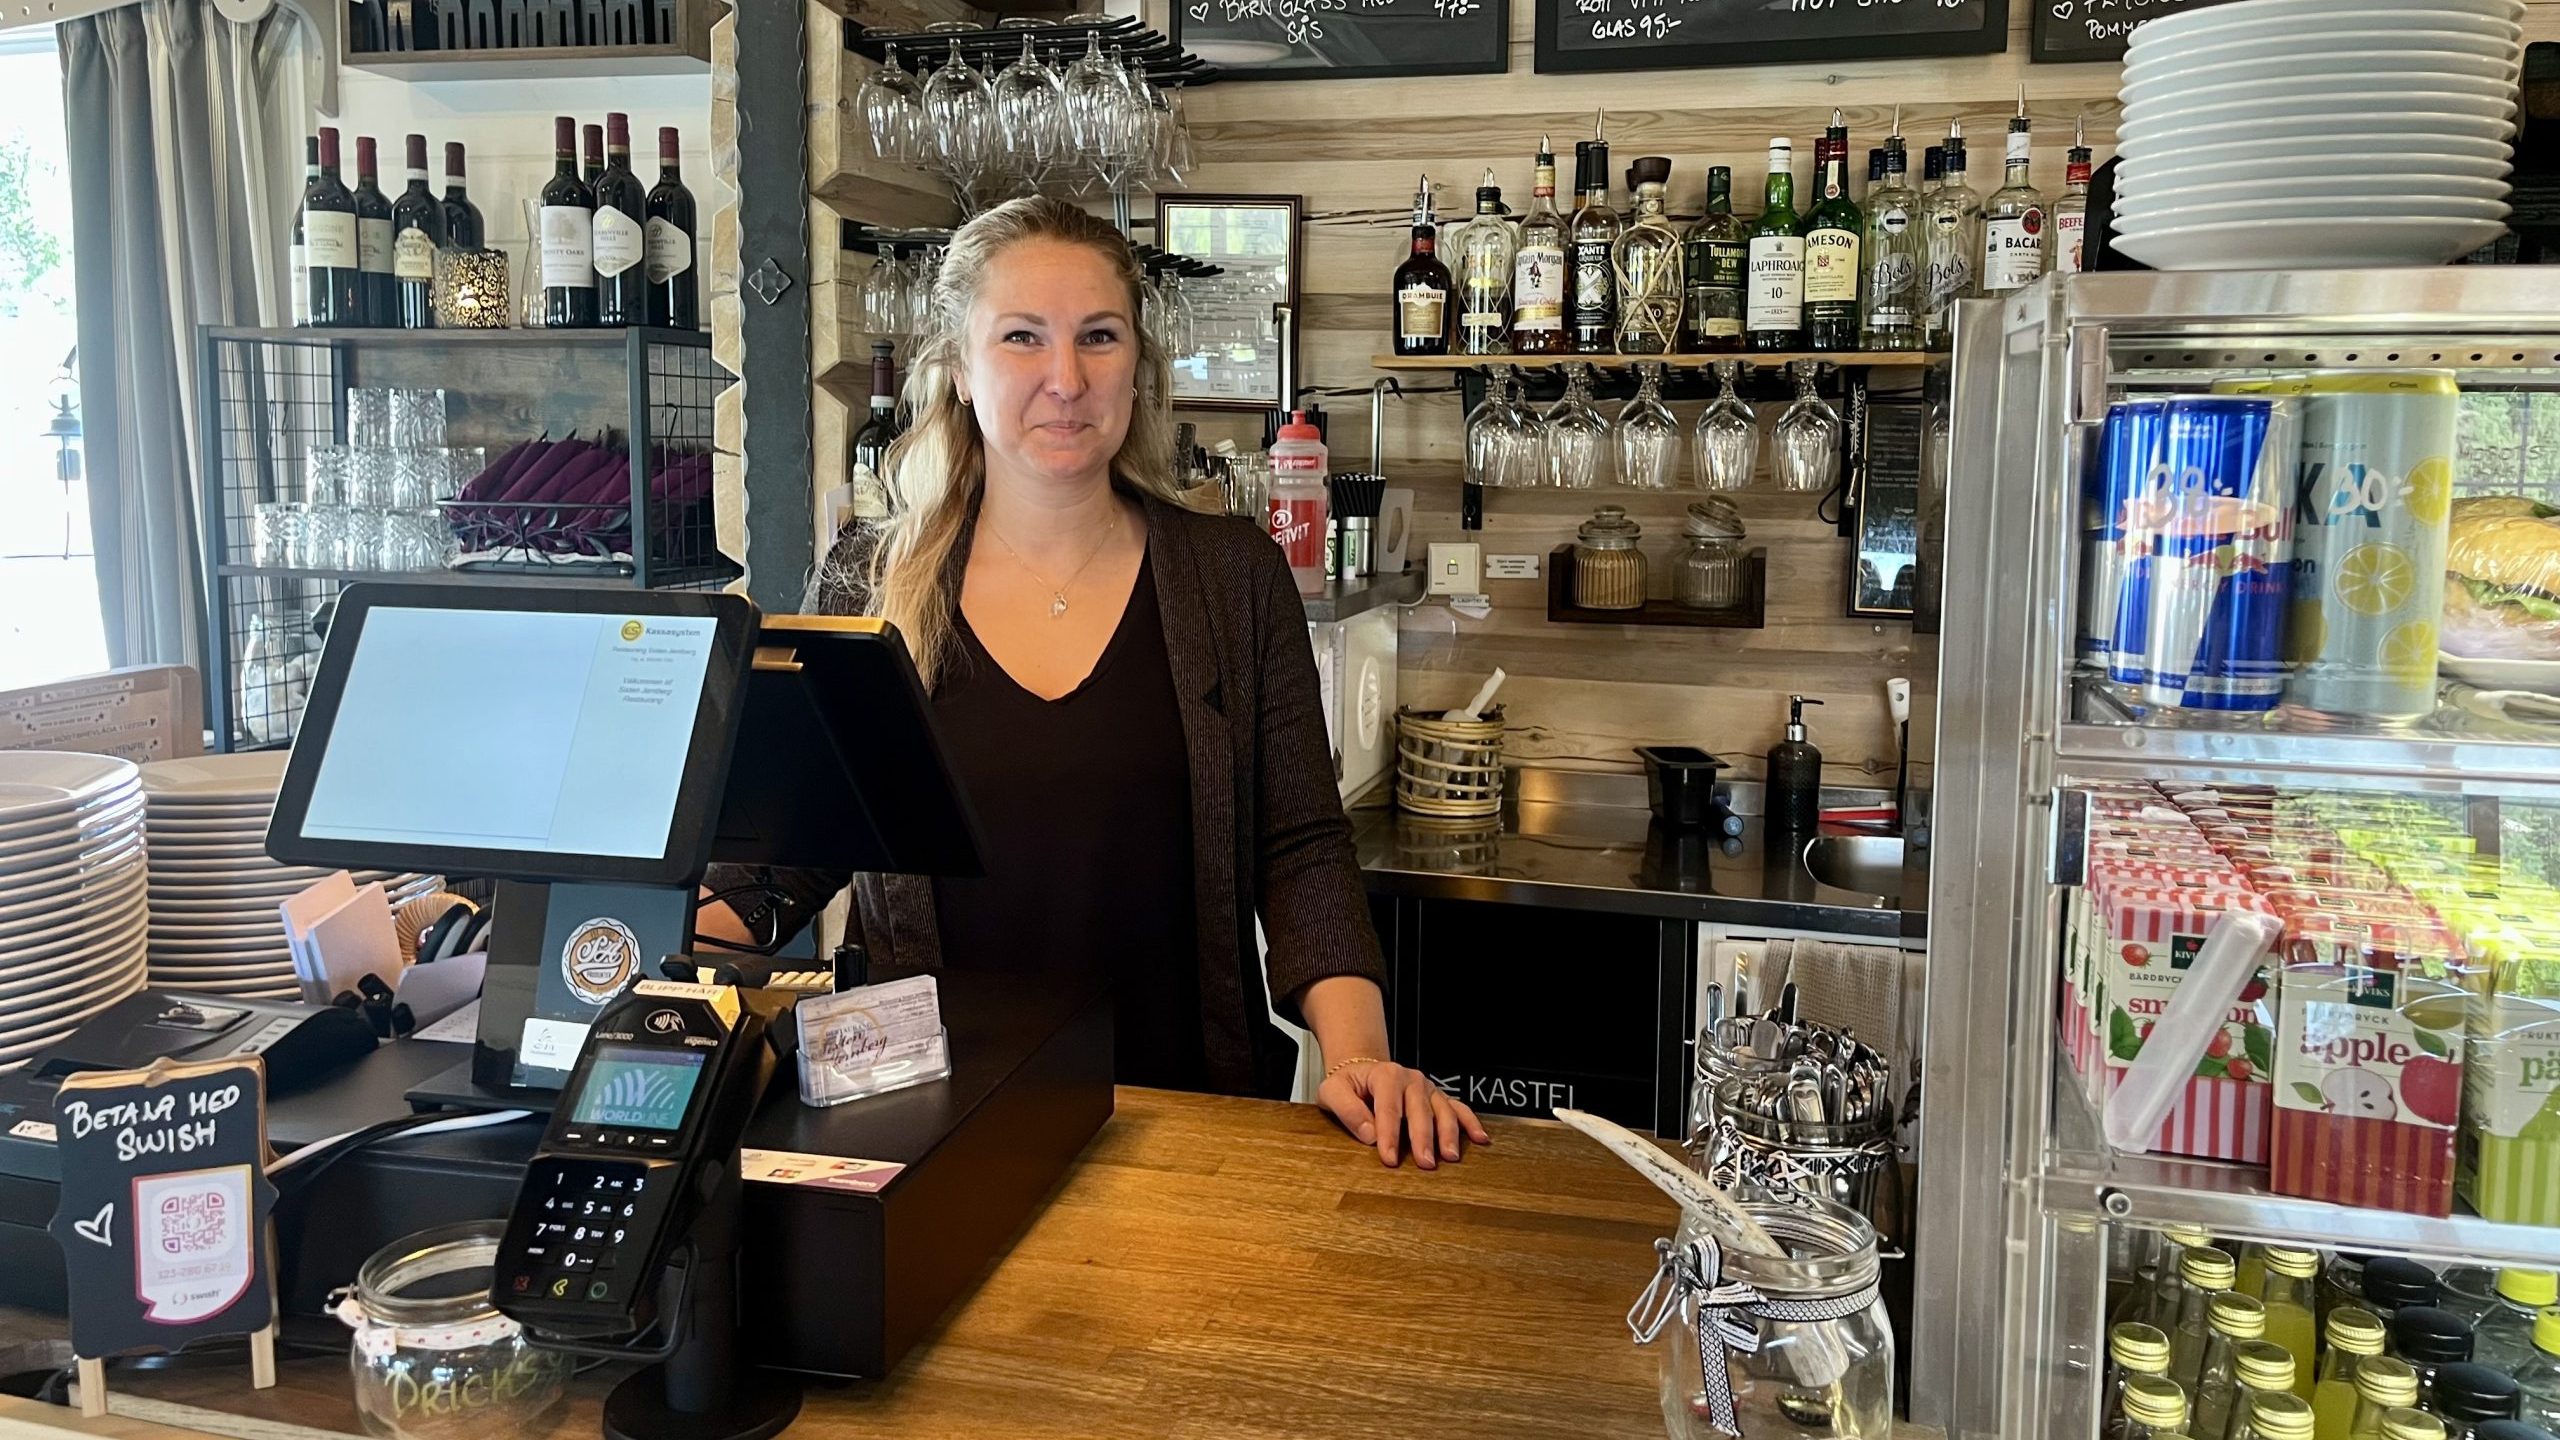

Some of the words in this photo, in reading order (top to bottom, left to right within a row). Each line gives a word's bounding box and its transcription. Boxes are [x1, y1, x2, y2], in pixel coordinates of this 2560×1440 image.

[1287, 15, 1323, 43] SÅS
[1592, 19, 1635, 39] GLAS
[1639, 13, 1682, 38] 95:-
[1751, 260, 1805, 272] LAPHROAIG
[1869, 254, 1912, 297] Bols
[1924, 253, 1965, 297] Bols
[1402, 292, 1443, 300] DRAMBUIE
[1771, 287, 1783, 299] 10
[684, 1036, 718, 1047] ingenico
[188, 1085, 241, 1117] MED
[590, 1107, 670, 1125] WORLDLINE
[116, 1118, 216, 1162] SWISH
[557, 1172, 564, 1185] 1
[593, 1175, 605, 1189] 2
[633, 1178, 644, 1192] 3
[545, 1197, 555, 1210] 4
[583, 1201, 595, 1215] 5
[623, 1203, 634, 1217] 6
[536, 1223, 547, 1236] 7
[574, 1226, 586, 1240] 8
[614, 1229, 625, 1244] 9
[564, 1252, 576, 1267] 0
